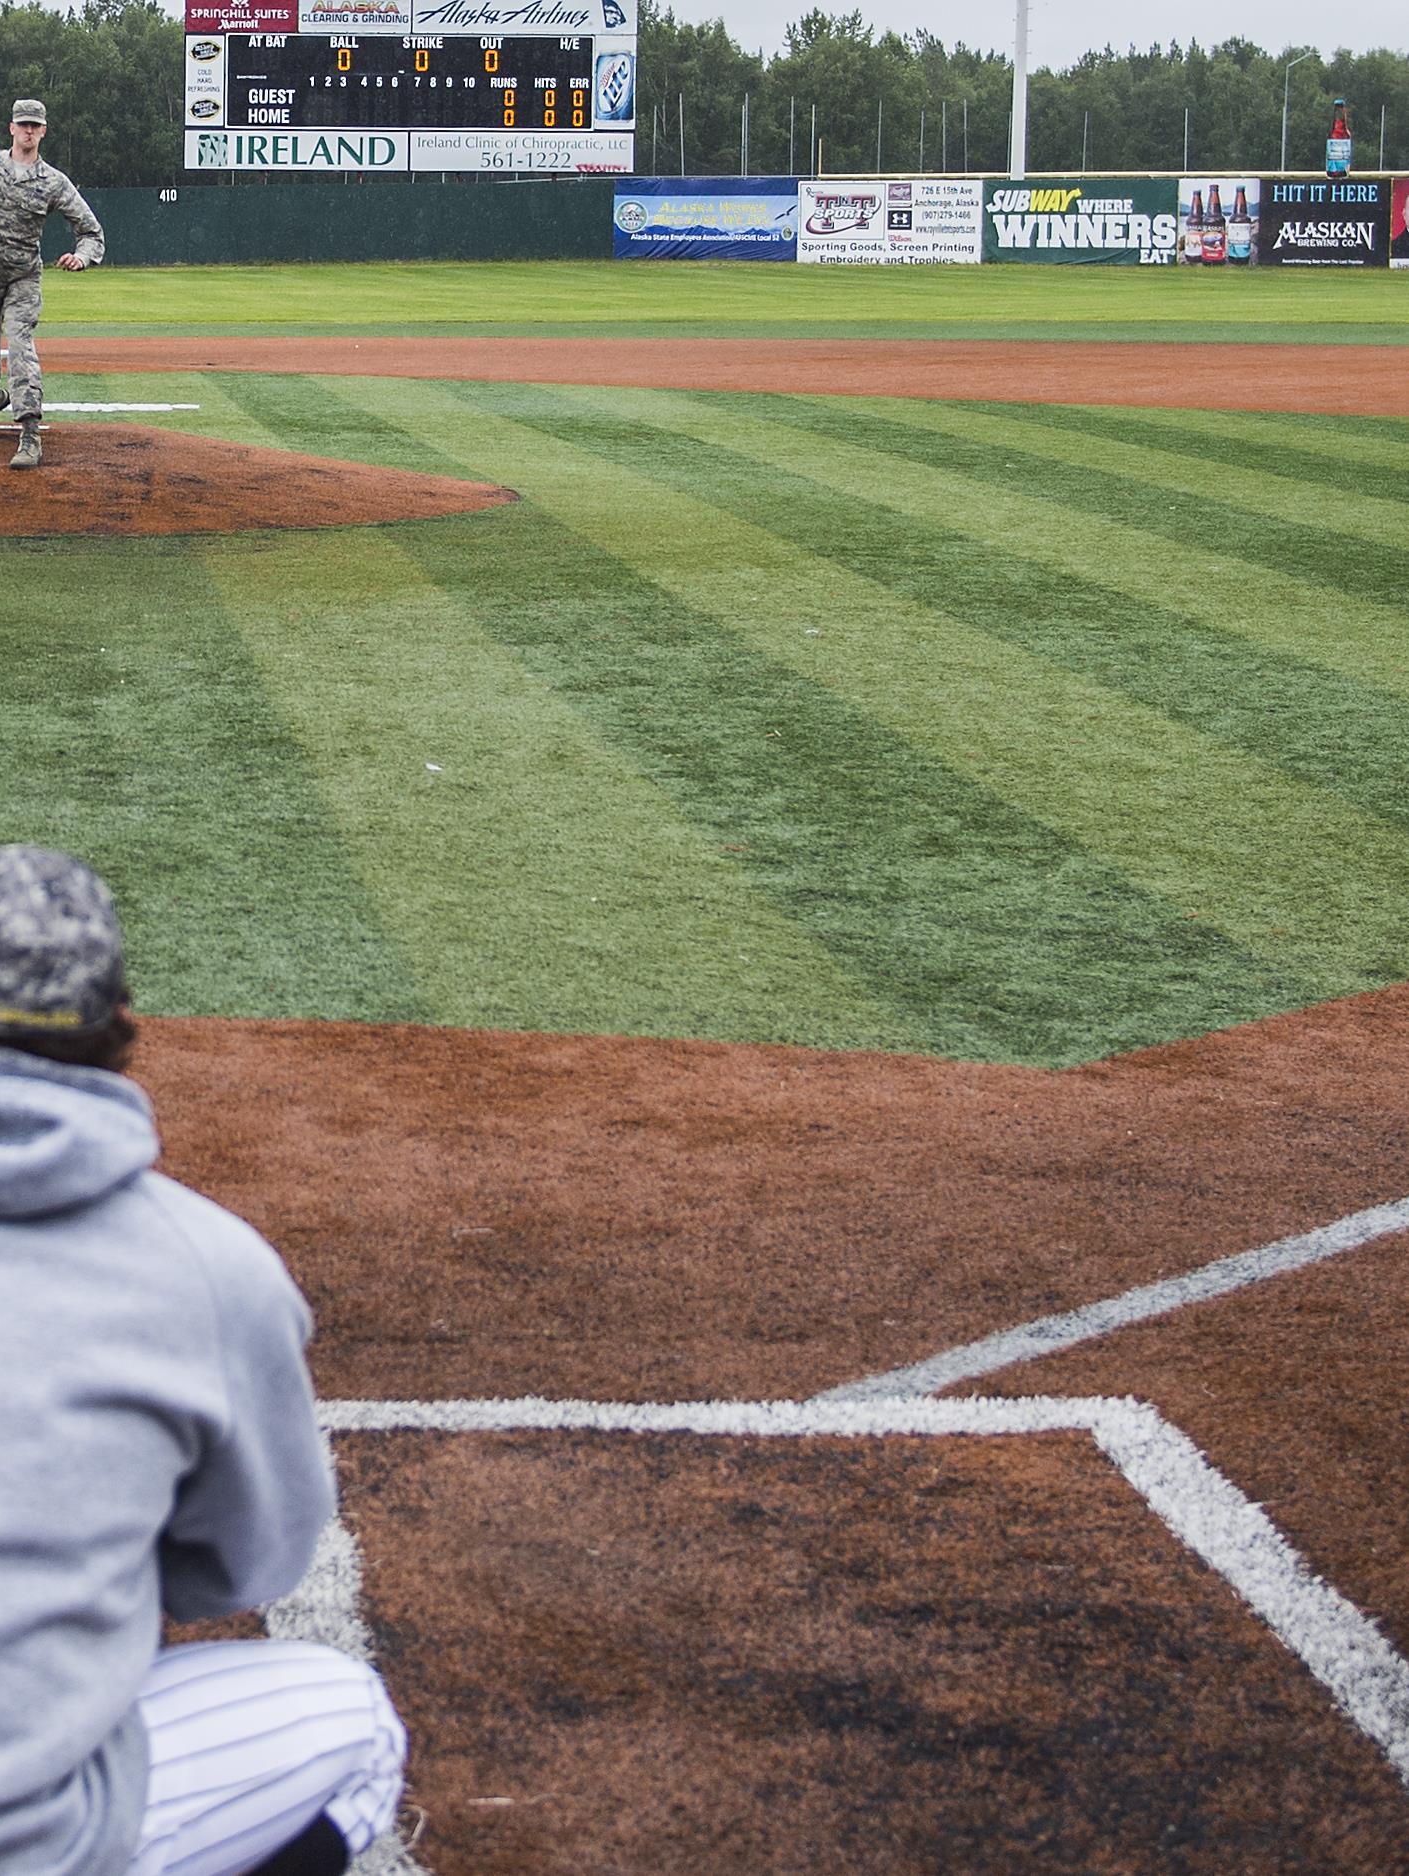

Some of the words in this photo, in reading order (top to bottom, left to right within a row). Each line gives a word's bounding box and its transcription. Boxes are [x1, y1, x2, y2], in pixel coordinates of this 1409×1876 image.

[311, 0, 400, 14] ALASKA
[416, 0, 499, 27] Alaska
[501, 0, 590, 28] Airlines
[190, 9, 253, 20] SPRINGHILL
[255, 9, 290, 20] SUITES
[301, 14, 348, 23] CLEARING
[351, 14, 359, 23] &
[361, 14, 409, 24] GRINDING
[218, 19, 259, 30] Marriott
[248, 36, 264, 48] AT
[265, 36, 287, 48] BAT
[330, 36, 358, 48] BALL
[402, 37, 443, 49] STRIKE
[480, 37, 504, 49] OUT
[560, 38, 580, 50] H/E
[337, 49, 351, 71] 0
[415, 50, 429, 72] 0
[484, 50, 499, 72] 0
[310, 76, 315, 87] 1
[325, 76, 332, 87] 2
[340, 76, 347, 87] 3
[360, 76, 367, 87] 4
[376, 76, 383, 87] 5
[391, 76, 398, 87] 6
[414, 77, 420, 88] 7
[429, 77, 437, 88] 8
[445, 77, 453, 88] 9
[463, 77, 475, 88] 10
[490, 77, 517, 88] RUNS
[534, 77, 557, 88] HITS
[569, 77, 590, 88] ERR
[248, 89, 296, 104] GUEST
[504, 89, 515, 107] 0
[545, 89, 555, 107] 0
[573, 89, 583, 107] 0
[248, 109, 290, 124] HOME
[504, 109, 515, 127] 0
[545, 109, 555, 127] 0
[573, 109, 583, 127] 0
[236, 136, 396, 166] IRELAND
[417, 137, 461, 149] Ireland
[465, 137, 501, 149] Clinic
[506, 137, 519, 149] of
[522, 137, 603, 152] Chiropractic,
[608, 140, 628, 150] LLC
[480, 152, 571, 168] 561-1222
[159, 189, 178, 202] 410
[943, 186, 958, 194] 15th
[1273, 185, 1306, 202] HIT
[1310, 185, 1327, 202] IT
[1332, 185, 1378, 202] HERE
[956, 199, 979, 207] Alaska
[986, 188, 1082, 213] SUBWAY
[1076, 199, 1133, 213] WHERE
[814, 208, 874, 220] SPORTS
[670, 234, 702, 242] Employees
[992, 214, 1177, 249] WINNERS
[1273, 222, 1375, 250] ALASKAN
[801, 242, 846, 252] Sporting
[850, 242, 886, 252] Goods,
[890, 243, 928, 252] Screen
[932, 243, 975, 253] Printing
[1297, 239, 1339, 248] BREWING
[1341, 239, 1357, 248] CO.
[819, 255, 881, 265] Embroidery
[884, 255, 905, 264] and
[908, 256, 955, 264] Trophies
[1140, 249, 1171, 264] EAT
